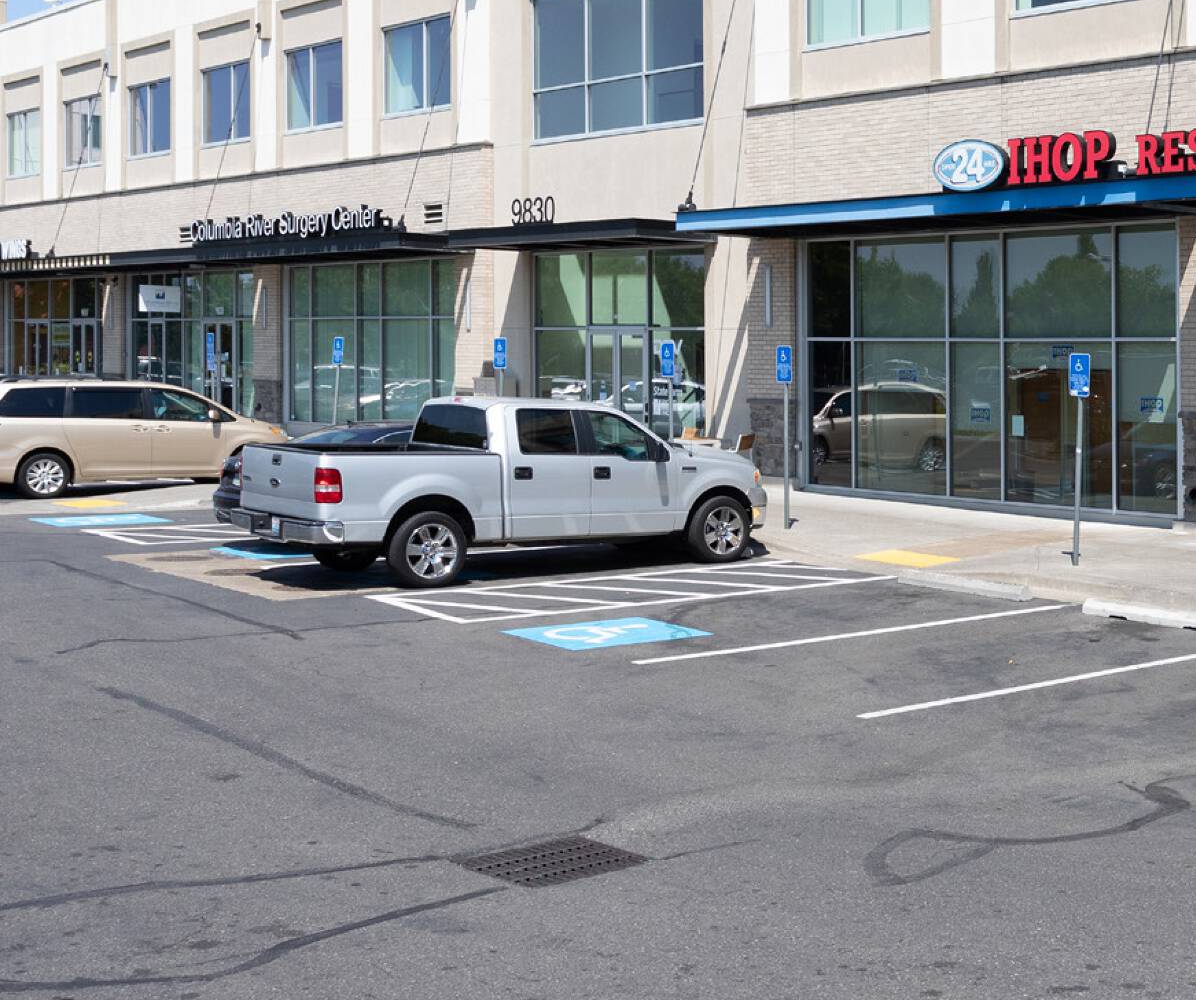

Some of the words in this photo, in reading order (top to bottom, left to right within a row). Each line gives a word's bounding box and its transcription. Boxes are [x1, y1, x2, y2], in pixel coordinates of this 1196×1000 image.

[951, 149, 985, 184] 24
[1007, 131, 1111, 185] IHOP
[190, 218, 242, 242] Columbia
[245, 214, 276, 238] River
[279, 211, 329, 239] Surgery
[331, 206, 377, 231] Center
[511, 196, 554, 224] 9830
